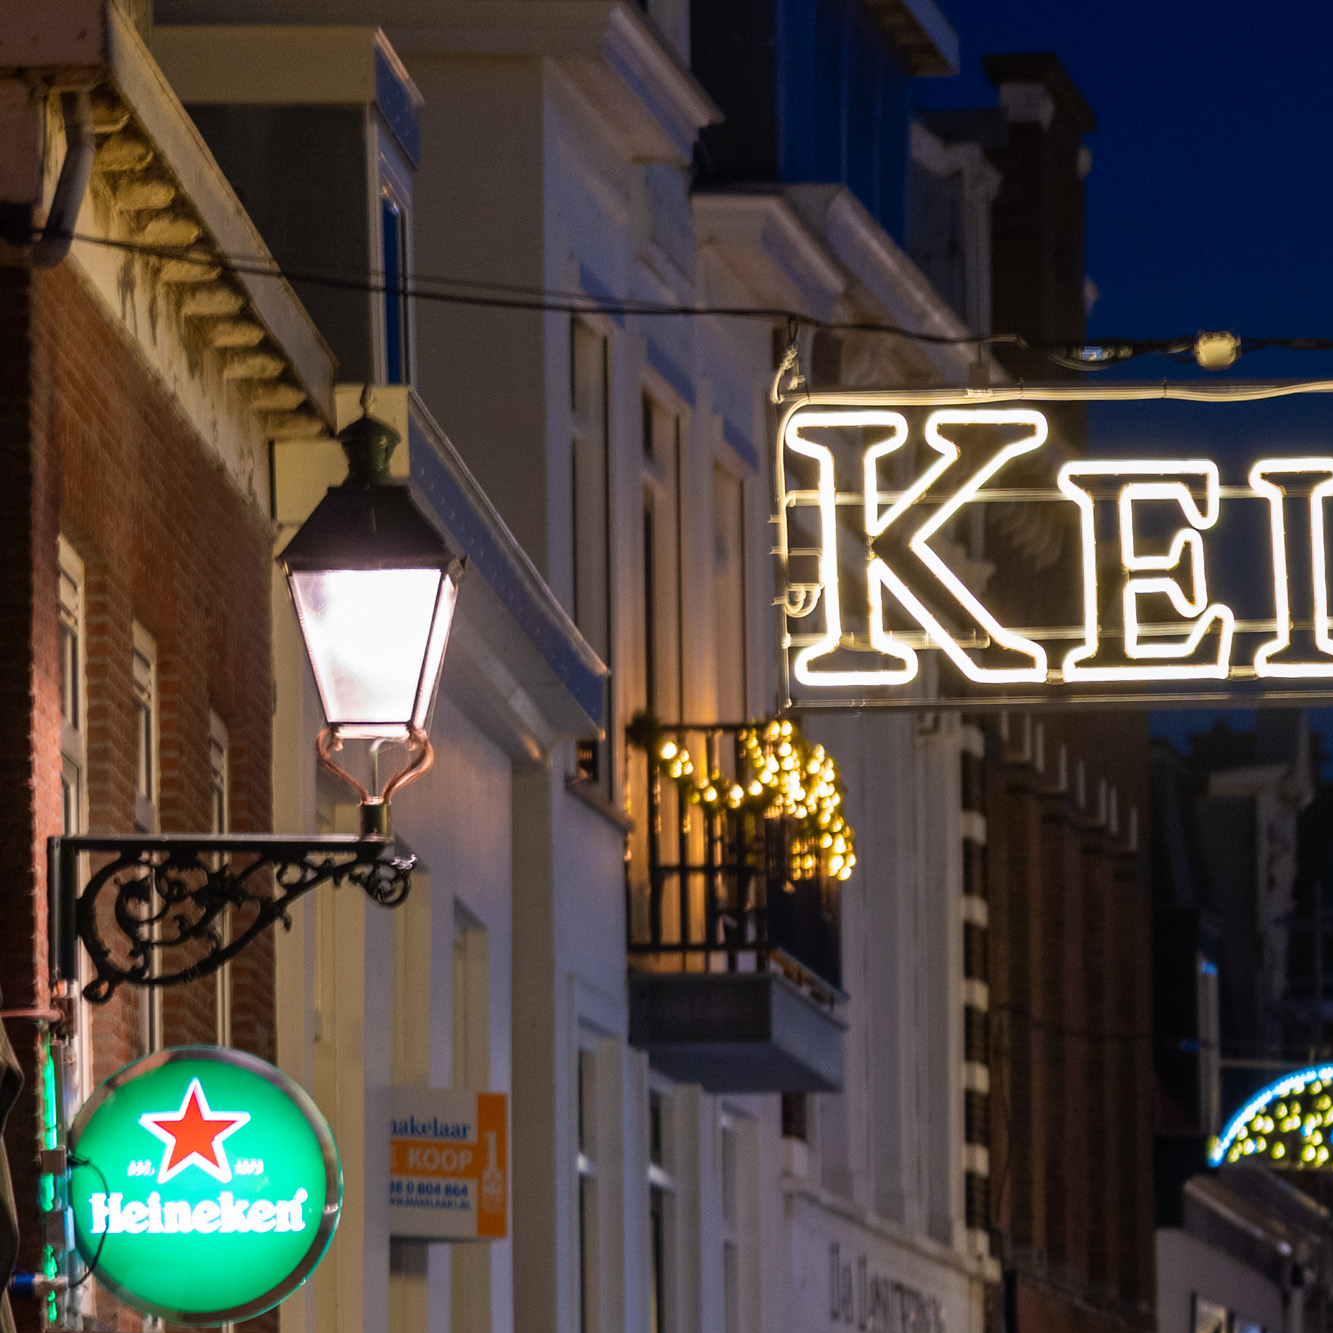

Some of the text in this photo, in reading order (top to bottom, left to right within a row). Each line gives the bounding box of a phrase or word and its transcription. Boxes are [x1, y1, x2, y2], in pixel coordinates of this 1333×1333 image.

[391, 1115, 470, 1140] akelaar
[408, 1147, 473, 1172] KOOP
[89, 1187, 308, 1234] Heineken
